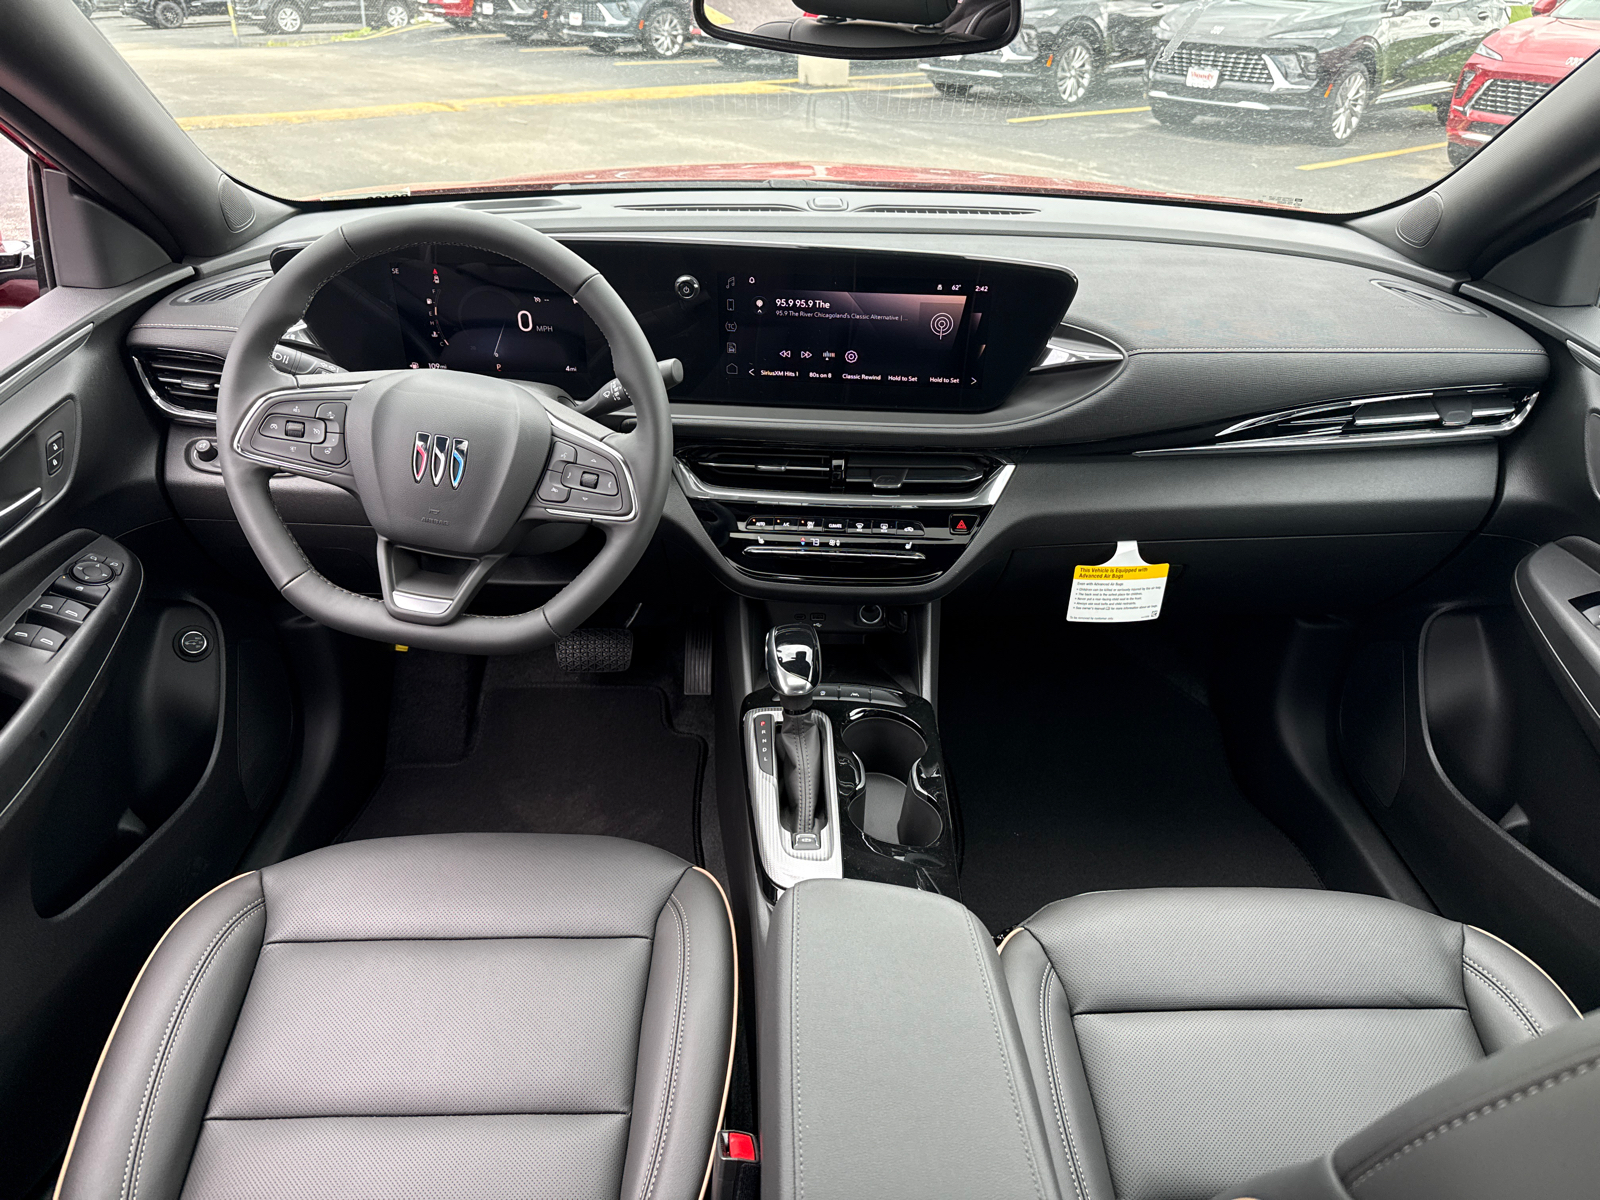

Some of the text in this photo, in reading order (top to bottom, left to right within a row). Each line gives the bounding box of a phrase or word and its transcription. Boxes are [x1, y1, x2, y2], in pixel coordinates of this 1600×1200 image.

[391, 267, 399, 275] SE
[775, 298, 830, 309] 95.9 95.9 The
[814, 311, 850, 319] Chicagoland's
[517, 310, 553, 333] 0 MPH
